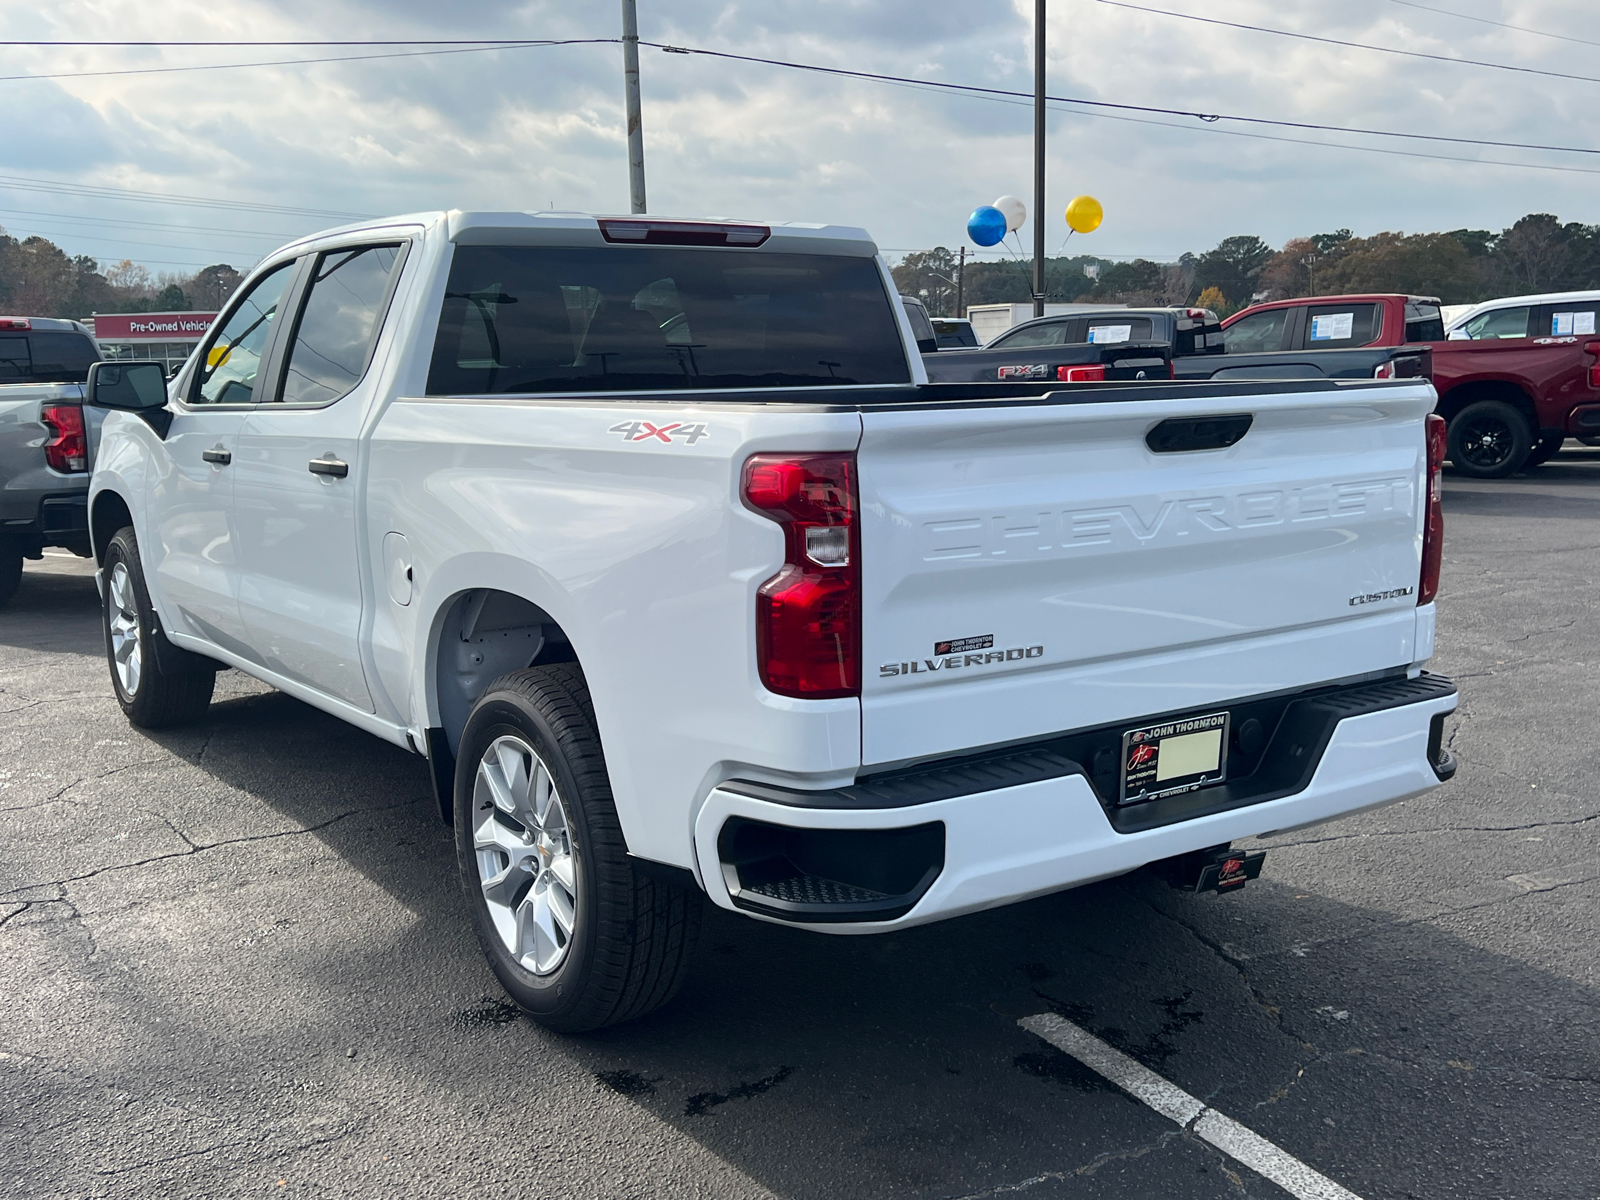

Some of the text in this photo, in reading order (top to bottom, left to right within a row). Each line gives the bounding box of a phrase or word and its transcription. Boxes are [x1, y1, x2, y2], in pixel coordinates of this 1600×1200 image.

[130, 321, 178, 332] Pre-Owned
[998, 364, 1047, 380] FX4
[923, 477, 1407, 560] CHEVROLET
[1349, 586, 1413, 606] CUSTOM
[950, 643, 982, 653] CHEVROLET
[951, 635, 993, 648] JOHN THORNTON
[880, 645, 1044, 678] SILVERADO
[1148, 726, 1174, 739] JOHN
[1175, 715, 1225, 733] THORNTON
[1159, 786, 1190, 798] CHEVROLET
